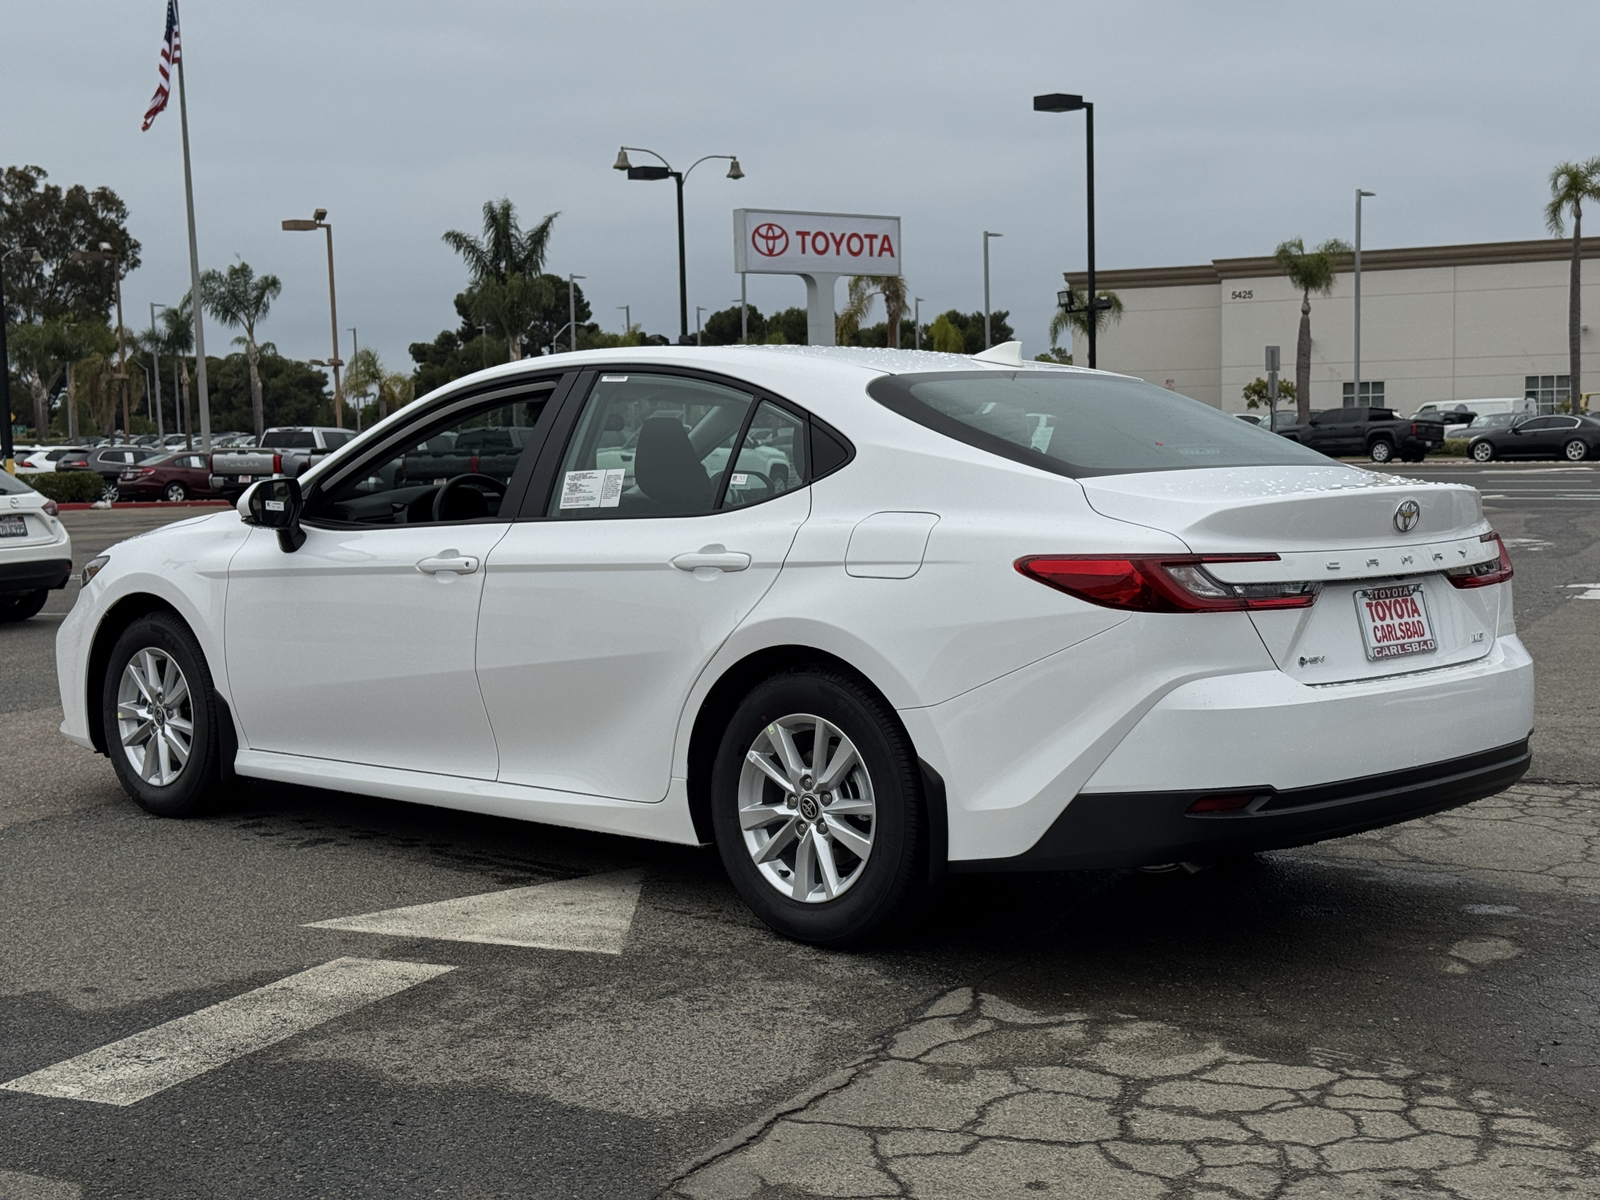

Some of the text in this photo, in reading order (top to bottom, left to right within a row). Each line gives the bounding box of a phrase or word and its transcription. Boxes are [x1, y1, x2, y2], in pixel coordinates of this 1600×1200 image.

[795, 230, 895, 258] TOYOTA
[1231, 290, 1253, 300] 5425
[1325, 549, 1467, 570] CAMRY
[1374, 587, 1410, 599] TOYOTA
[1365, 597, 1421, 623] TOYOTA
[1373, 620, 1425, 644] CARLSBAD
[1374, 640, 1435, 657] CARLSBAD
